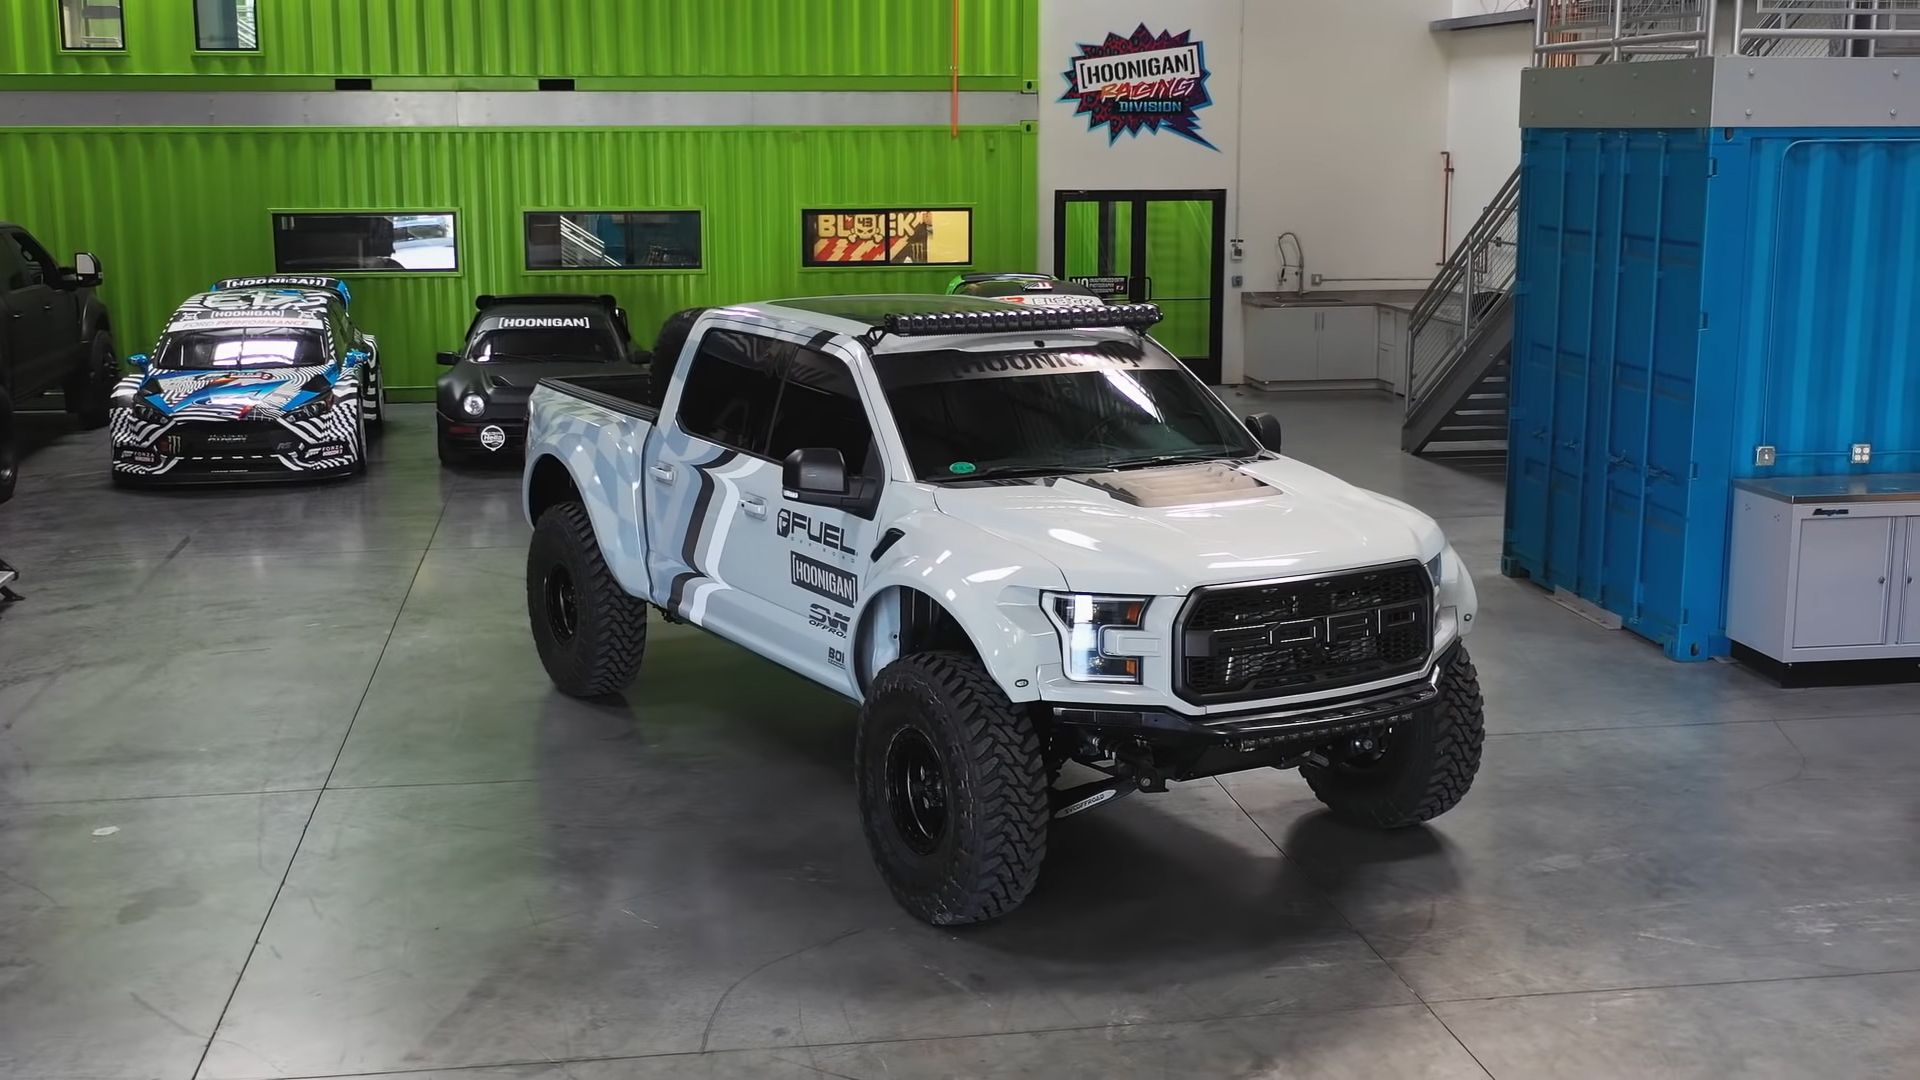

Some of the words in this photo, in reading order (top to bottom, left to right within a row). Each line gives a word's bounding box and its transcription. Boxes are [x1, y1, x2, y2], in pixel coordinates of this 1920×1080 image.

[1100, 77, 1195, 103] RACING
[1119, 101, 1182, 112] DIVISION
[791, 511, 856, 556] FUEL
